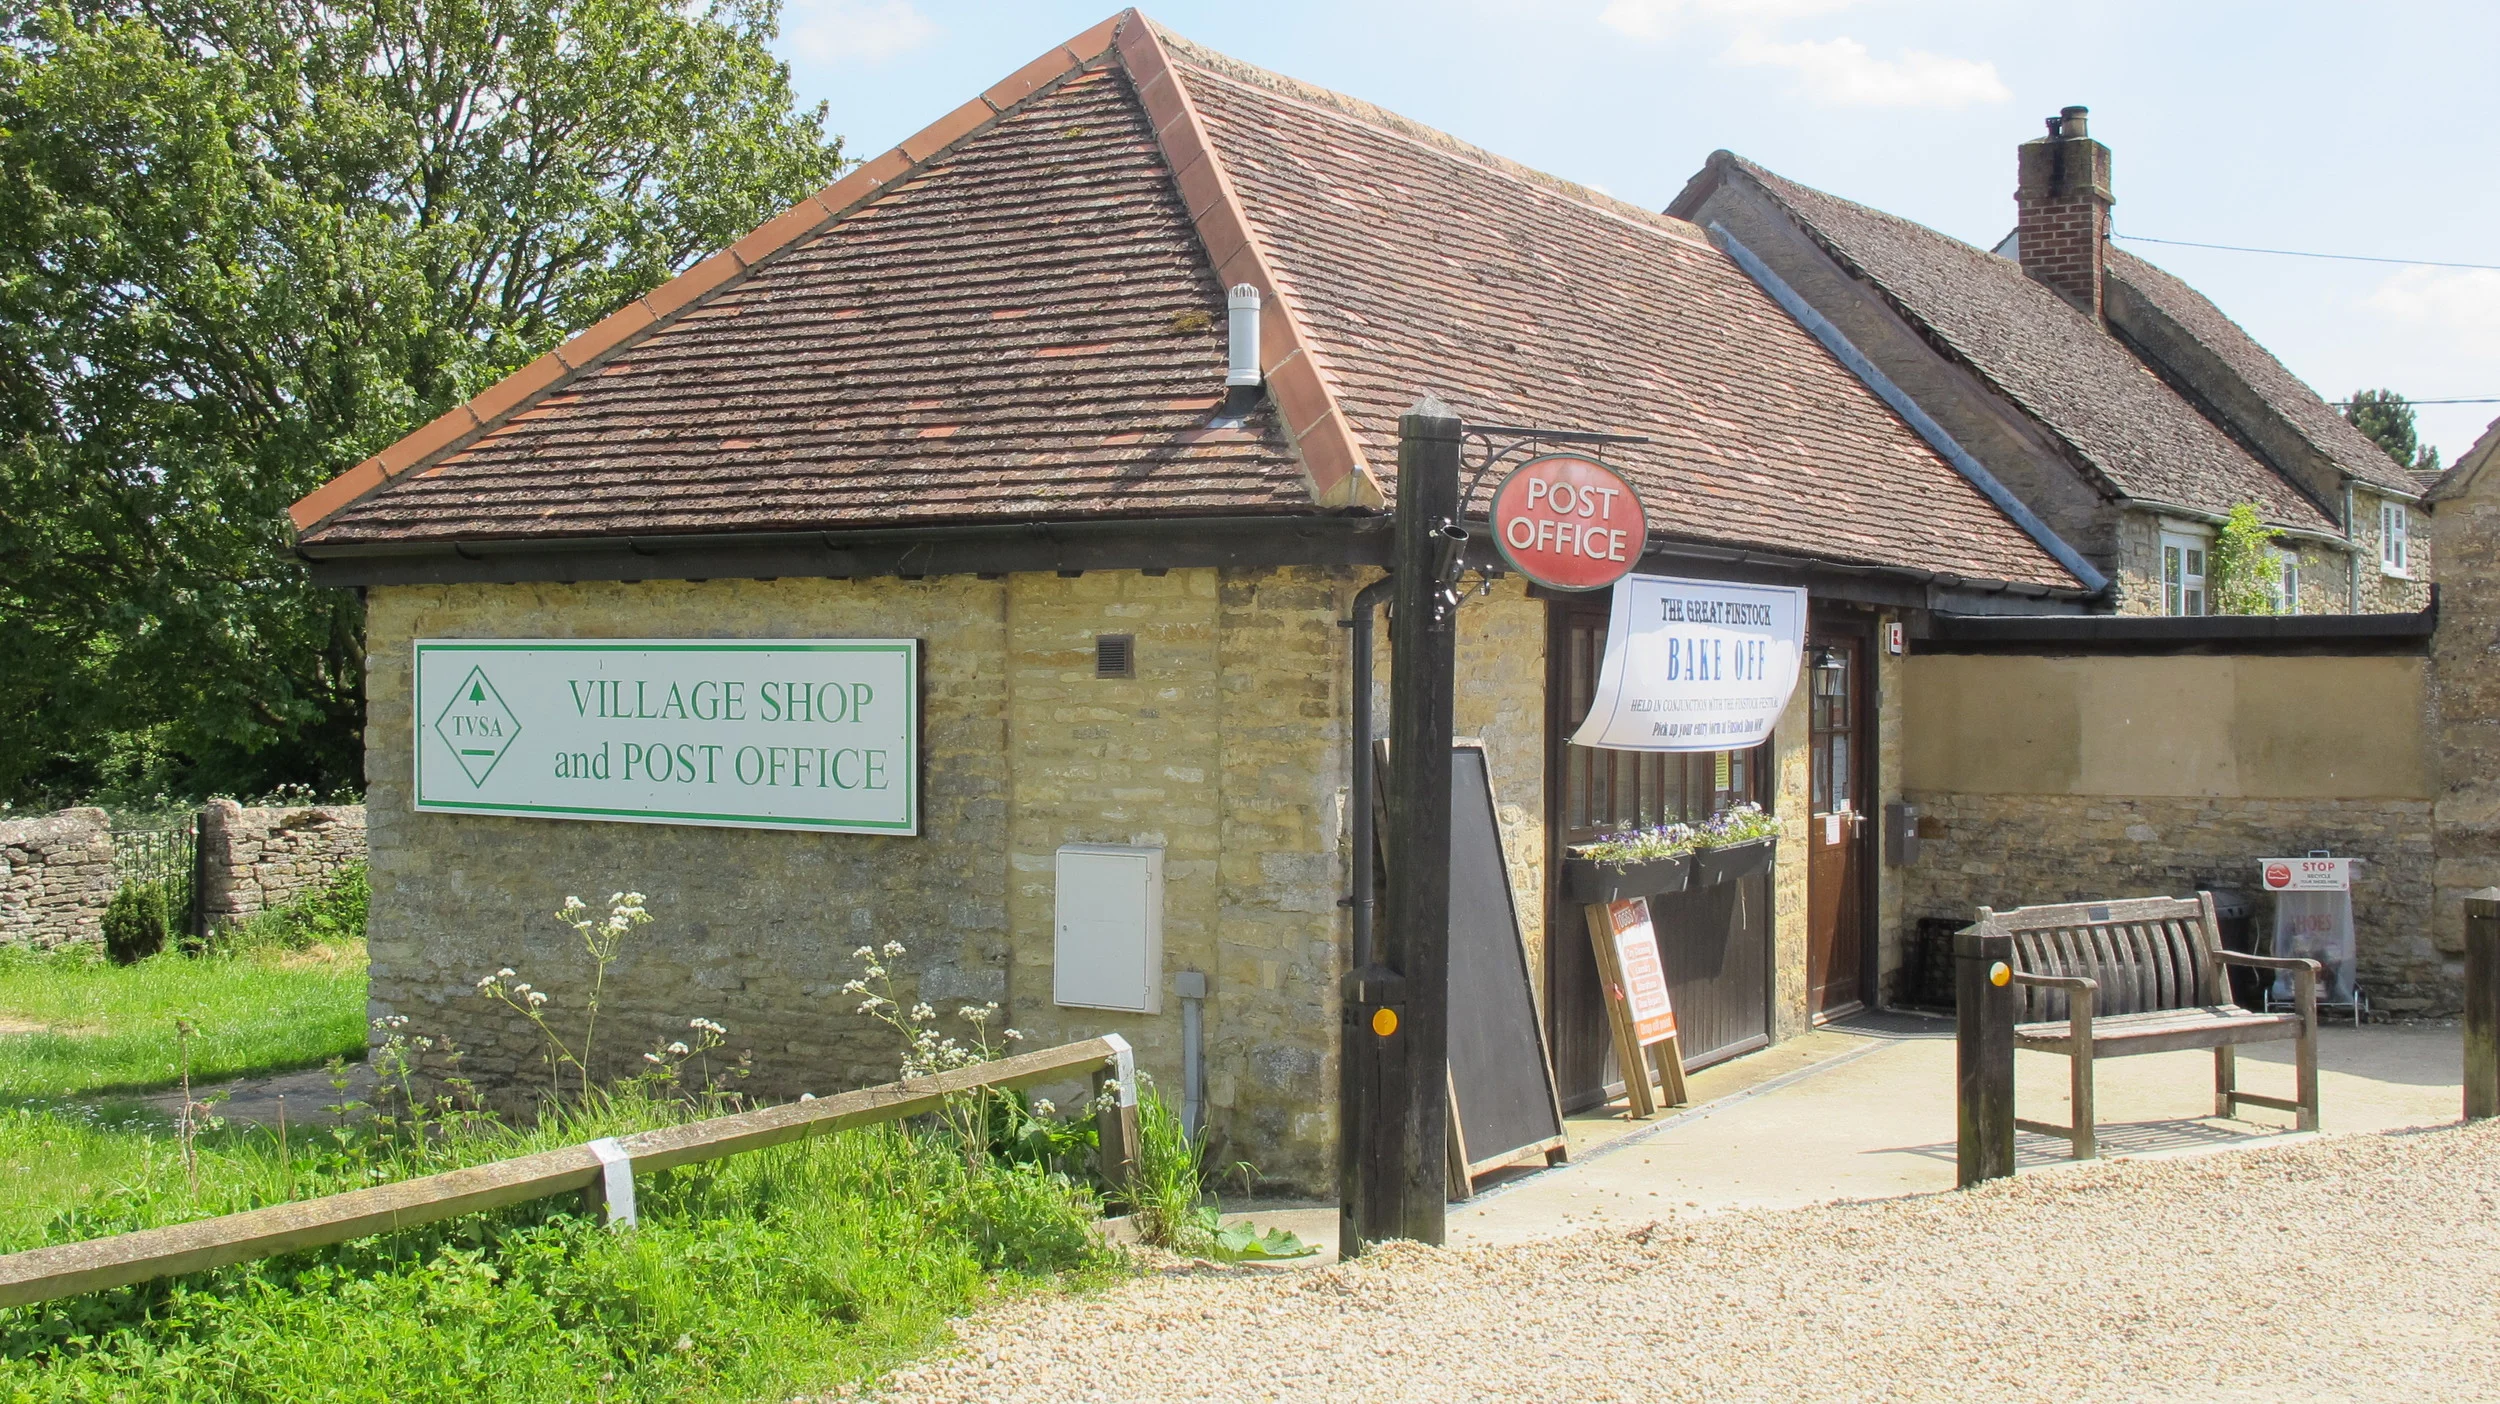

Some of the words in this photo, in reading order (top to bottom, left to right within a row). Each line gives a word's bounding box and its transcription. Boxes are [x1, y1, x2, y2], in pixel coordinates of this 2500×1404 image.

[1527, 478, 1619, 520] POST
[1507, 516, 1627, 562] OFFICE
[1661, 598, 1684, 621] THE
[1686, 600, 1723, 624] GREAT
[1725, 602, 1772, 626] FINSTOCK
[1667, 638, 1721, 680] BAKE
[1735, 640, 1765, 680] OFF
[568, 680, 747, 720] VILLAGE
[760, 681, 874, 723] SHOP
[1630, 699, 1653, 712] HELD
[1653, 699, 1661, 712] IN
[1662, 698, 1707, 712] CONJUNCTION
[452, 715, 504, 738] TVSA
[1652, 722, 1668, 736] Pick
[1669, 723, 1678, 738] up
[1678, 722, 1693, 738] your
[554, 741, 612, 780] and
[622, 742, 724, 784] POST
[734, 745, 890, 790] OFFICE
[2302, 862, 2335, 872] STOP
